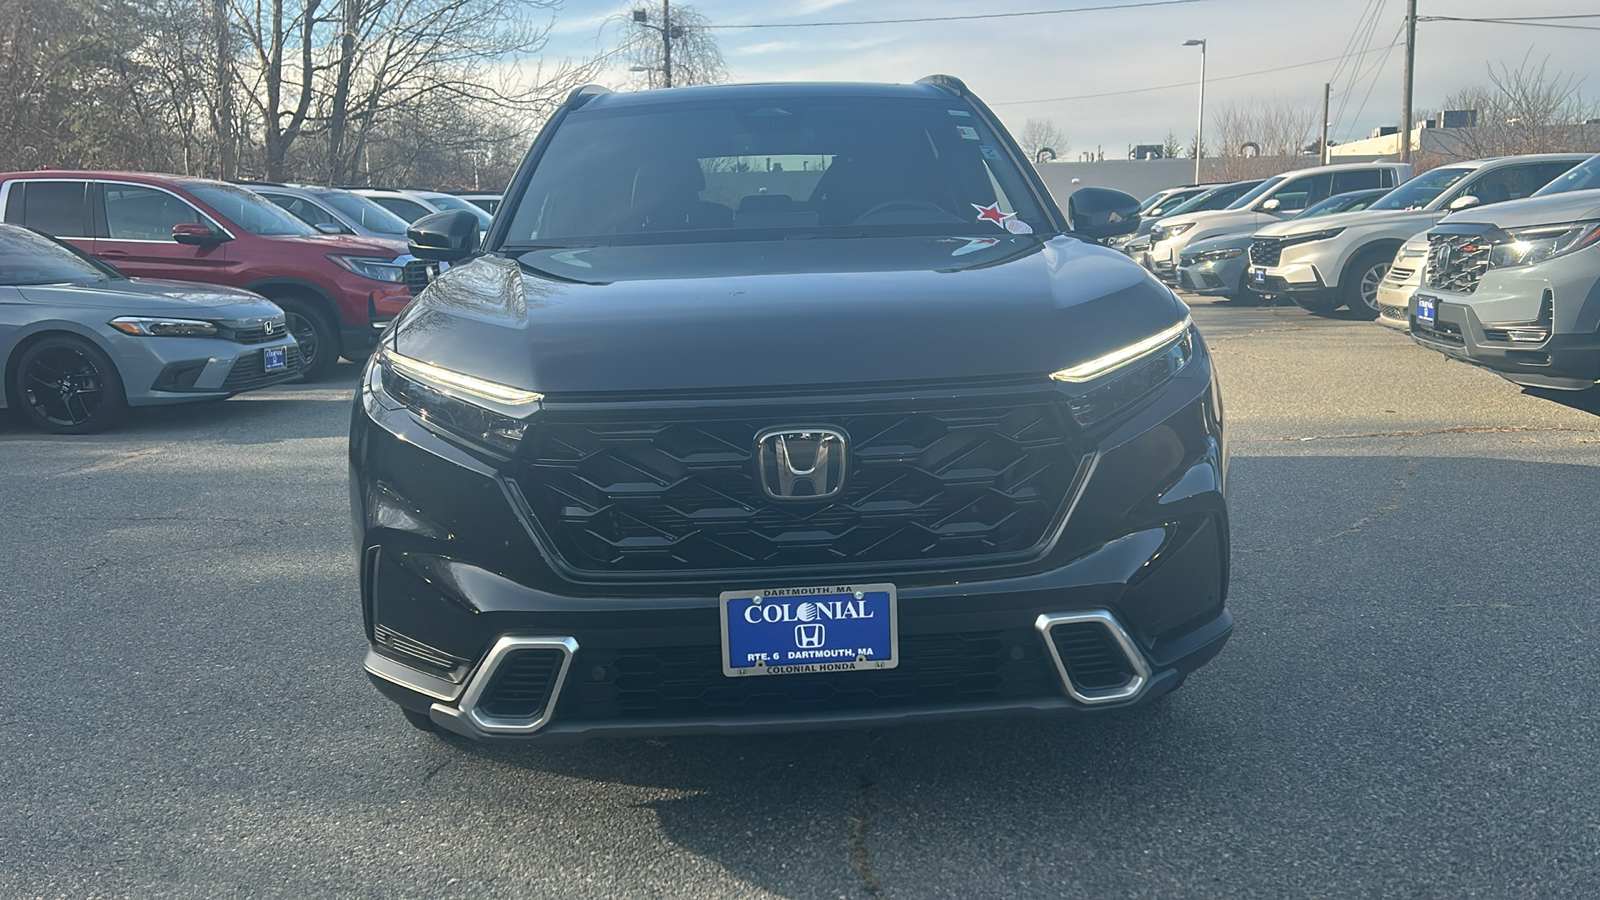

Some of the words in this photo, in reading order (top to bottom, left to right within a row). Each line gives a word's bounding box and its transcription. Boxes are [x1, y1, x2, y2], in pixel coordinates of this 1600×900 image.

[836, 585, 854, 594] MA
[744, 600, 874, 624] COLONIAL
[747, 652, 771, 662] RTE.
[772, 652, 780, 660] 6
[787, 648, 856, 660] DARTMOUTH,
[857, 647, 874, 656] MA
[766, 662, 817, 675] COLONIAL
[819, 662, 856, 673] HONDA
